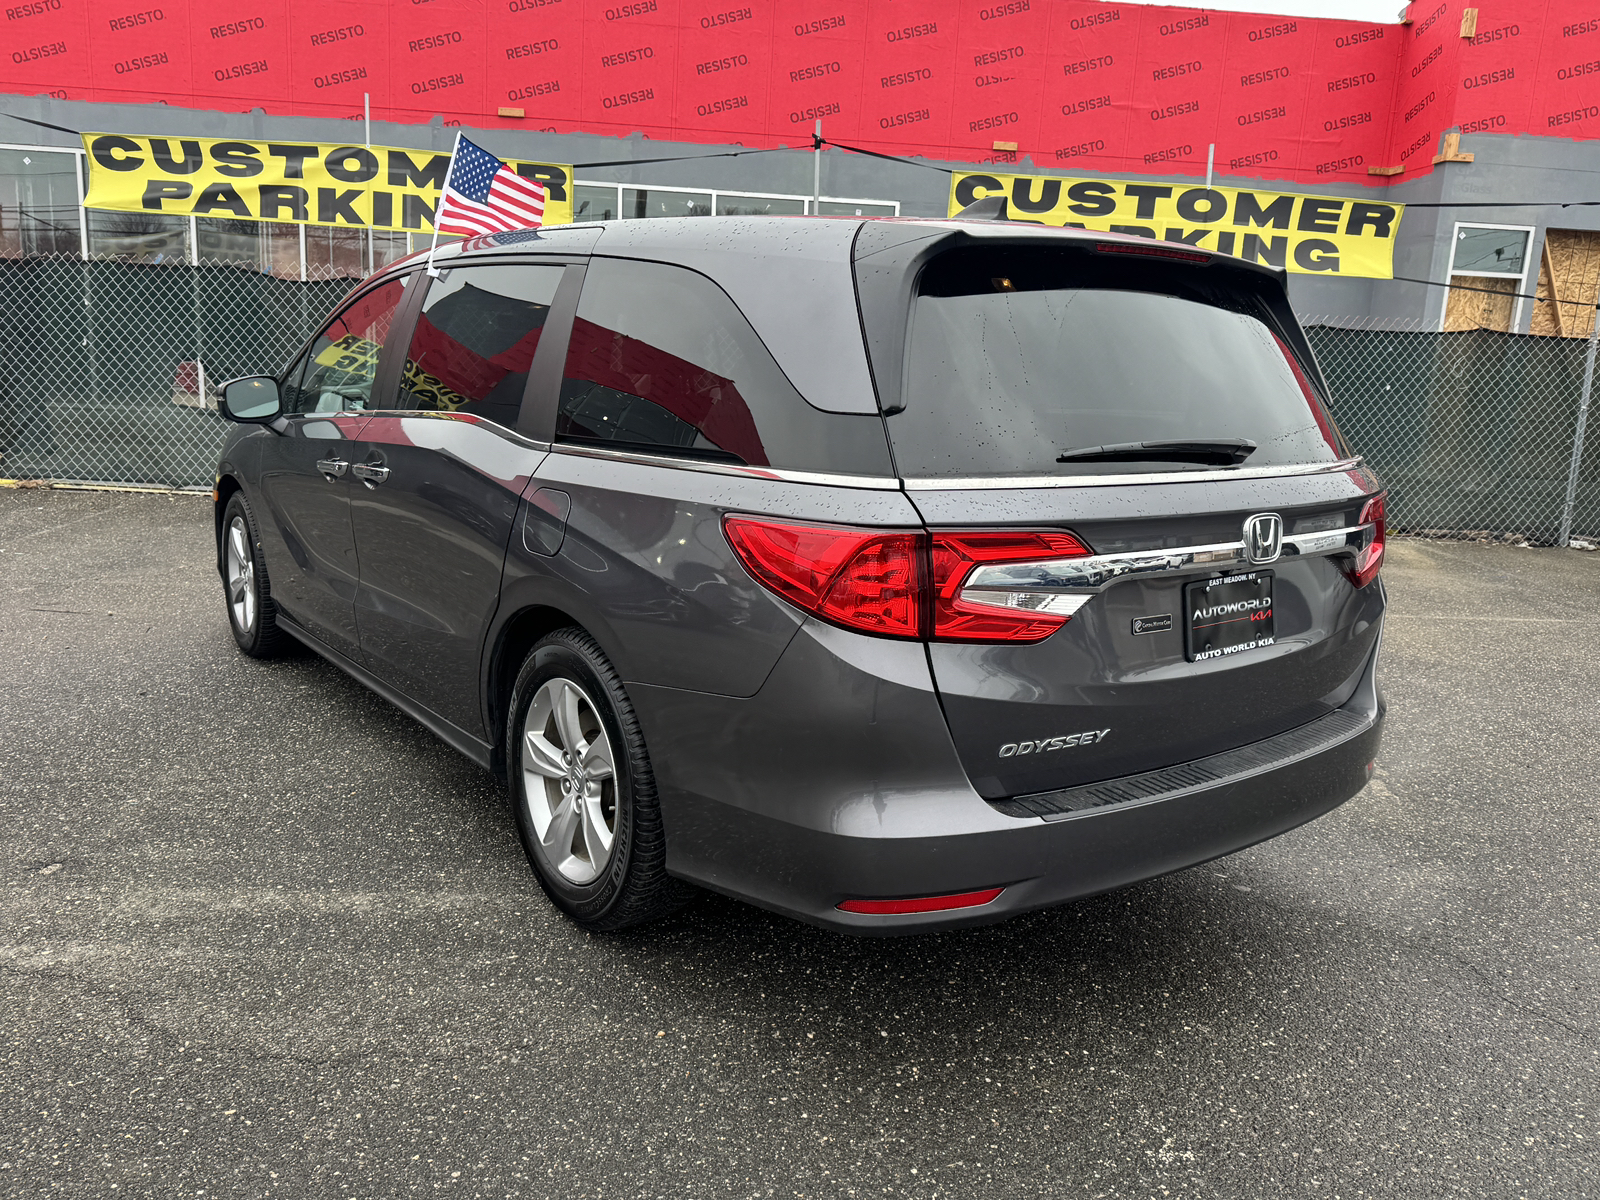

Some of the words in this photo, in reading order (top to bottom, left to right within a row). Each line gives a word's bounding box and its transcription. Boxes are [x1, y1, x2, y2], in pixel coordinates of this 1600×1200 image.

[6, 0, 61, 20] RESISTO
[109, 9, 164, 32] RESISTO
[606, 0, 658, 20] RESISTO
[701, 8, 752, 29] RESISTO
[980, 0, 1030, 20] RESISTO
[1070, 10, 1120, 31] RESISTO
[210, 17, 265, 39] RESISTO
[795, 15, 846, 37] RESISTO
[1160, 15, 1209, 37] RESISTO
[1415, 3, 1447, 39] RESISTO
[1562, 19, 1600, 38] RESIS
[310, 25, 365, 46] RESISTO
[408, 31, 462, 52] RESISTO
[887, 22, 938, 43] RESISTO
[1248, 22, 1297, 42] RESISTO
[1336, 28, 1384, 48] RESISTO
[12, 41, 67, 64] RESISTO
[506, 39, 559, 60] RESISTO
[602, 47, 654, 68] RESISTO
[974, 46, 1024, 67] RESISTO
[114, 52, 169, 75] RESISTO
[214, 60, 268, 82] RESISTO
[696, 54, 748, 75] RESISTO
[1064, 56, 1114, 76] RESISTO
[1153, 61, 1202, 81] RESISTO
[1411, 44, 1442, 78] RESISTO
[1557, 61, 1600, 80] ESISTO
[314, 67, 367, 89] RESISTO
[790, 62, 841, 83] RESISTO
[881, 68, 932, 89] RESISTO
[1241, 67, 1290, 87] RESISTO
[1327, 73, 1376, 93] RESISTO
[1463, 68, 1515, 90] RESISTO
[411, 73, 465, 94] RESISTO
[508, 80, 560, 102] RESISTO
[603, 88, 655, 109] RESISTO
[697, 96, 748, 116] RESISTO
[1062, 96, 1111, 116] RESISTO
[1405, 92, 1436, 123] RESISTO
[789, 102, 841, 124] RESISTO
[880, 109, 930, 129] RESISTO
[1151, 101, 1199, 121] RESISTO
[1238, 107, 1286, 126] RESISTO
[1548, 106, 1599, 127] RESISTO
[970, 112, 1019, 132] RESISTO
[1324, 112, 1372, 132] RESISTO
[1056, 140, 1104, 160] RESISTO
[1144, 145, 1192, 165] RESISTO
[1400, 131, 1431, 162] RESISTO
[92, 135, 567, 202] CUSTOMR
[1230, 150, 1279, 170] RESISTO
[1316, 155, 1364, 175] RESISTO
[141, 179, 437, 230] PARKIN
[955, 174, 1396, 237] CUSTOMER
[1209, 578, 1223, 587] EAST
[1248, 573, 1256, 581] NY
[1193, 597, 1272, 621] AUTOWORLD
[1195, 649, 1222, 662] AUTO
[1223, 641, 1256, 655] WORLD
[1258, 638, 1275, 647] KIA
[998, 728, 1111, 758] ODYSSEY
